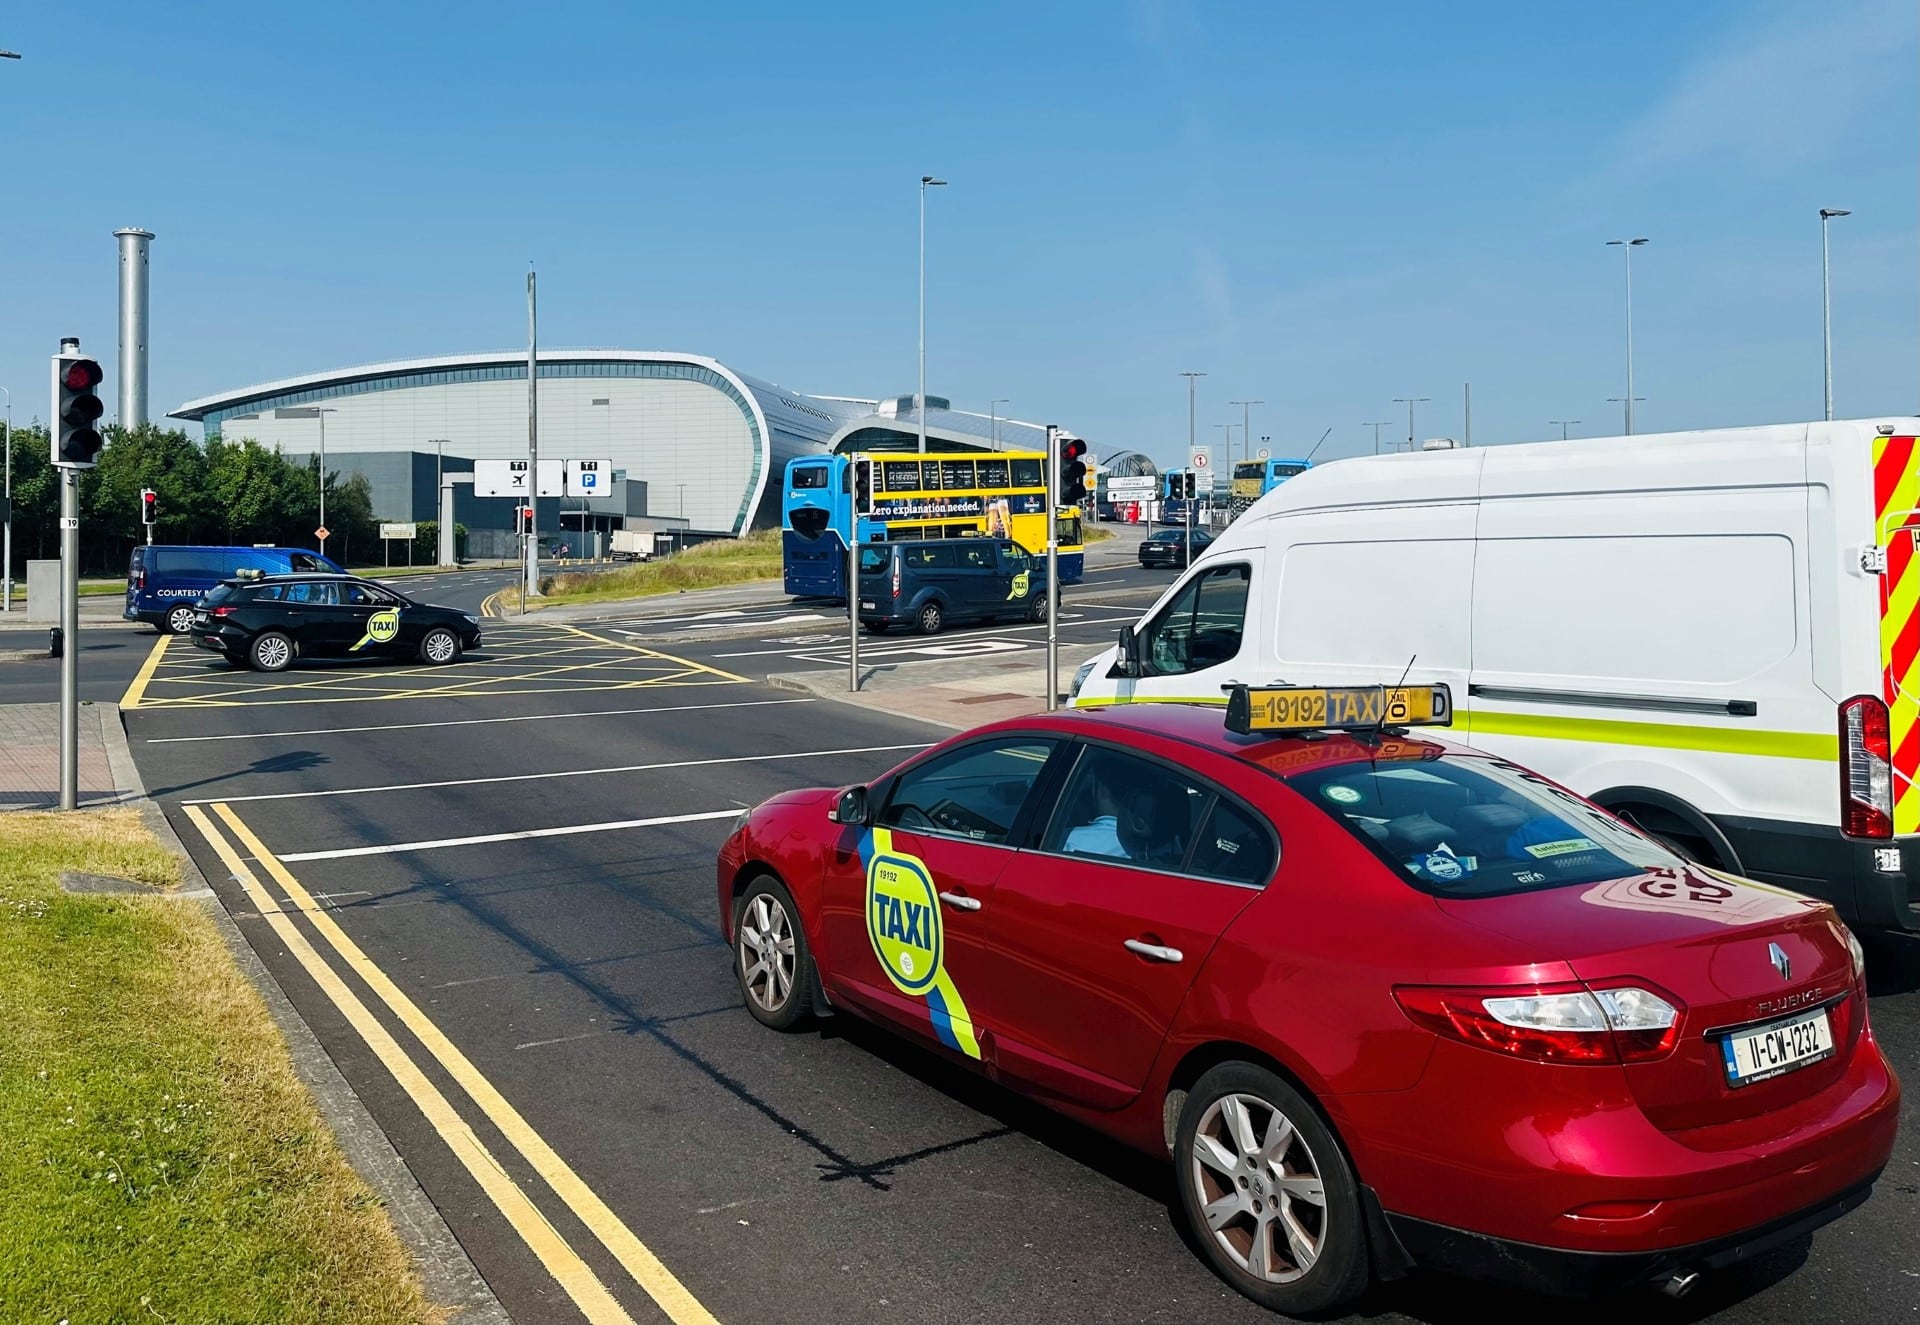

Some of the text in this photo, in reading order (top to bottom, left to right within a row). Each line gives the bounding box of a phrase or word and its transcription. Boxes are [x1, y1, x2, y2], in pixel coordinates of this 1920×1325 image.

[513, 462, 526, 471] T1
[583, 462, 596, 471] T1
[893, 502, 946, 516] explanation
[947, 501, 980, 512] needed.
[68, 519, 77, 527] 19
[157, 589, 201, 597] COURTESY
[372, 621, 394, 632] TAXI
[1266, 691, 1382, 723] 19192 TAXI
[1432, 692, 1446, 717] D
[880, 870, 898, 882] 19192
[874, 892, 931, 951] TAXI
[1759, 987, 1822, 1013] FLUENCE
[1748, 1021, 1819, 1069] 11-CW-1232
